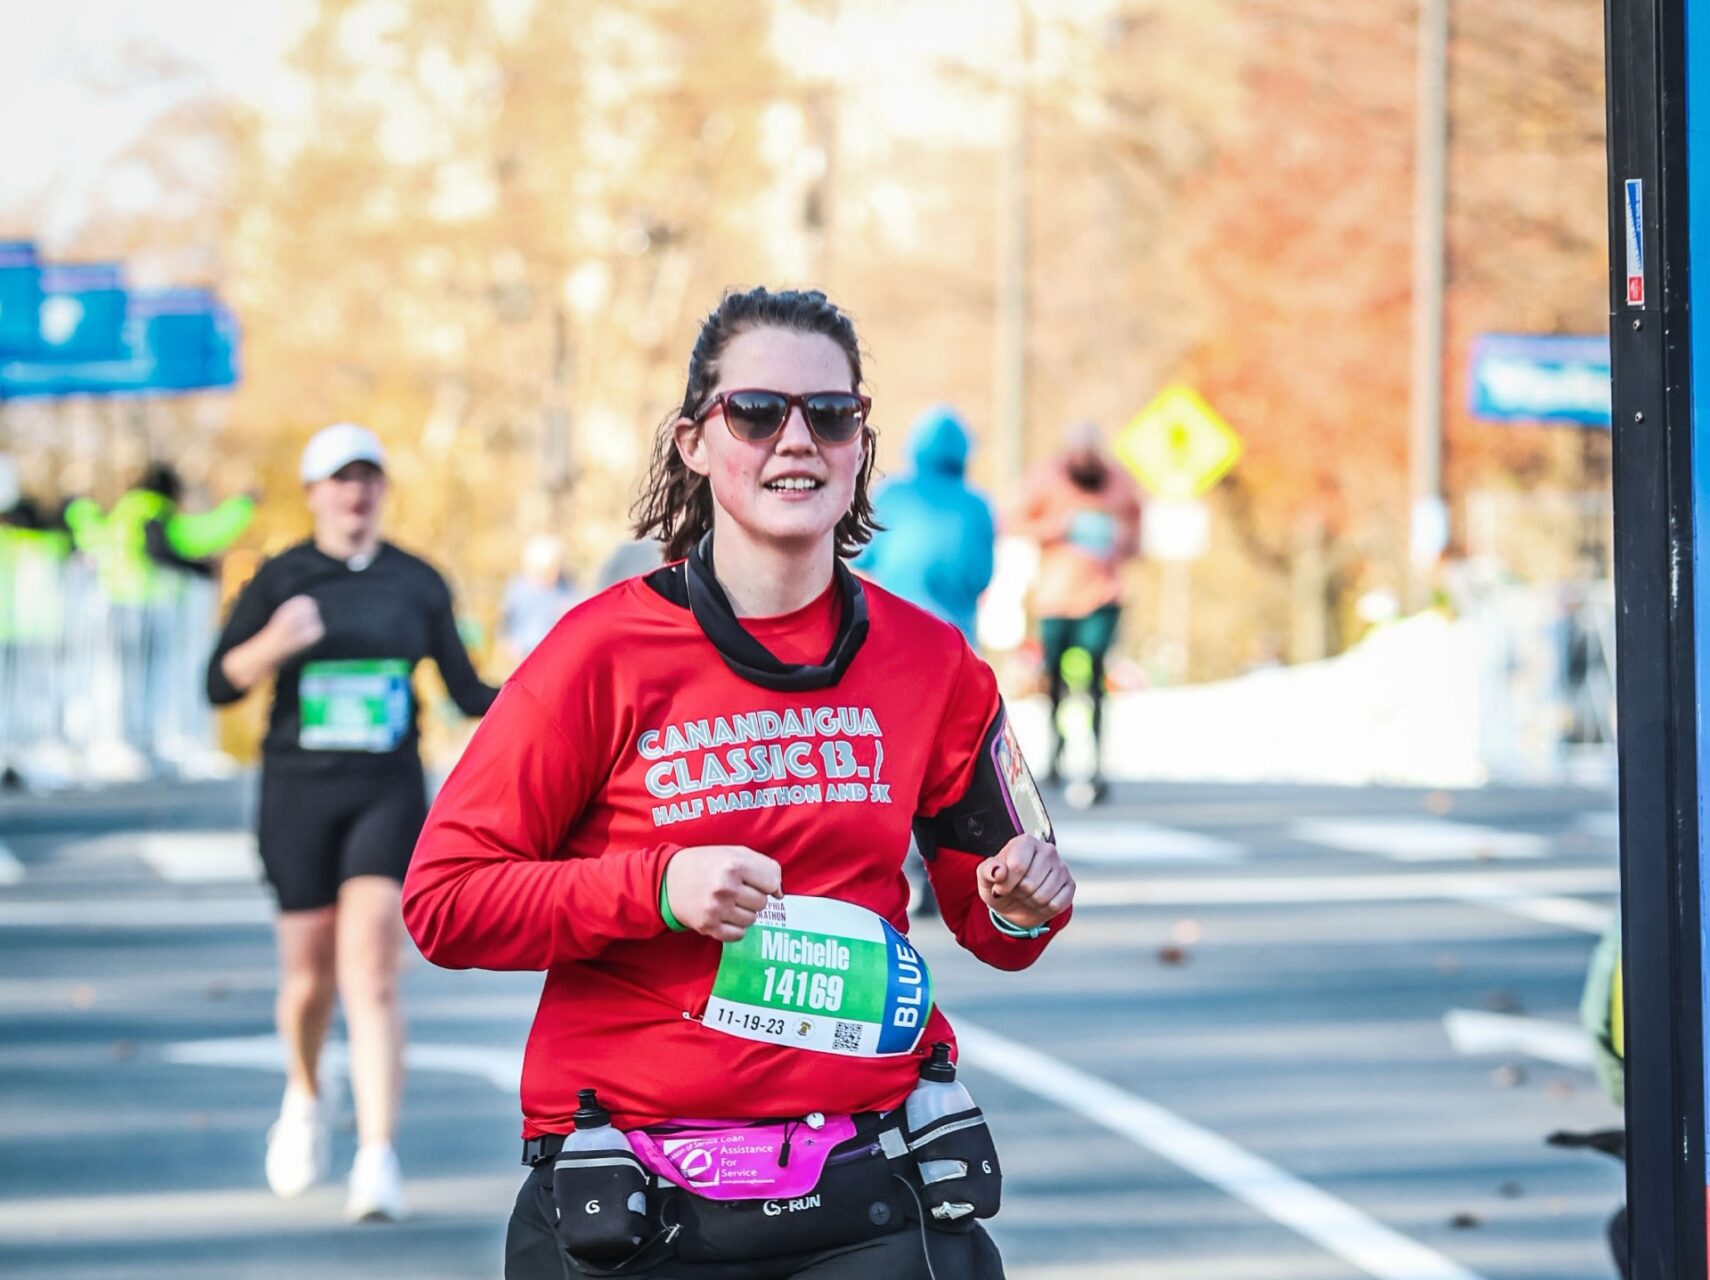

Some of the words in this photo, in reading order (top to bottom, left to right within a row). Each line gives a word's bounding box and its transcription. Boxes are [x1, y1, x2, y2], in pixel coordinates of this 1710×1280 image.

[636, 706, 883, 760] CANANDAIGUA
[645, 742, 817, 799] CLASSIC
[651, 799, 704, 826] HALF
[708, 784, 822, 815] MARATHON
[826, 783, 868, 802] AND
[871, 784, 892, 804] 5K
[761, 930, 850, 970] Michelle
[763, 966, 844, 1012] 14169
[893, 943, 922, 1028] BLUE
[717, 1008, 785, 1035] 11-19-23
[720, 1145, 774, 1154] Assistance
[721, 1158, 737, 1167] For
[721, 1169, 758, 1178] Service
